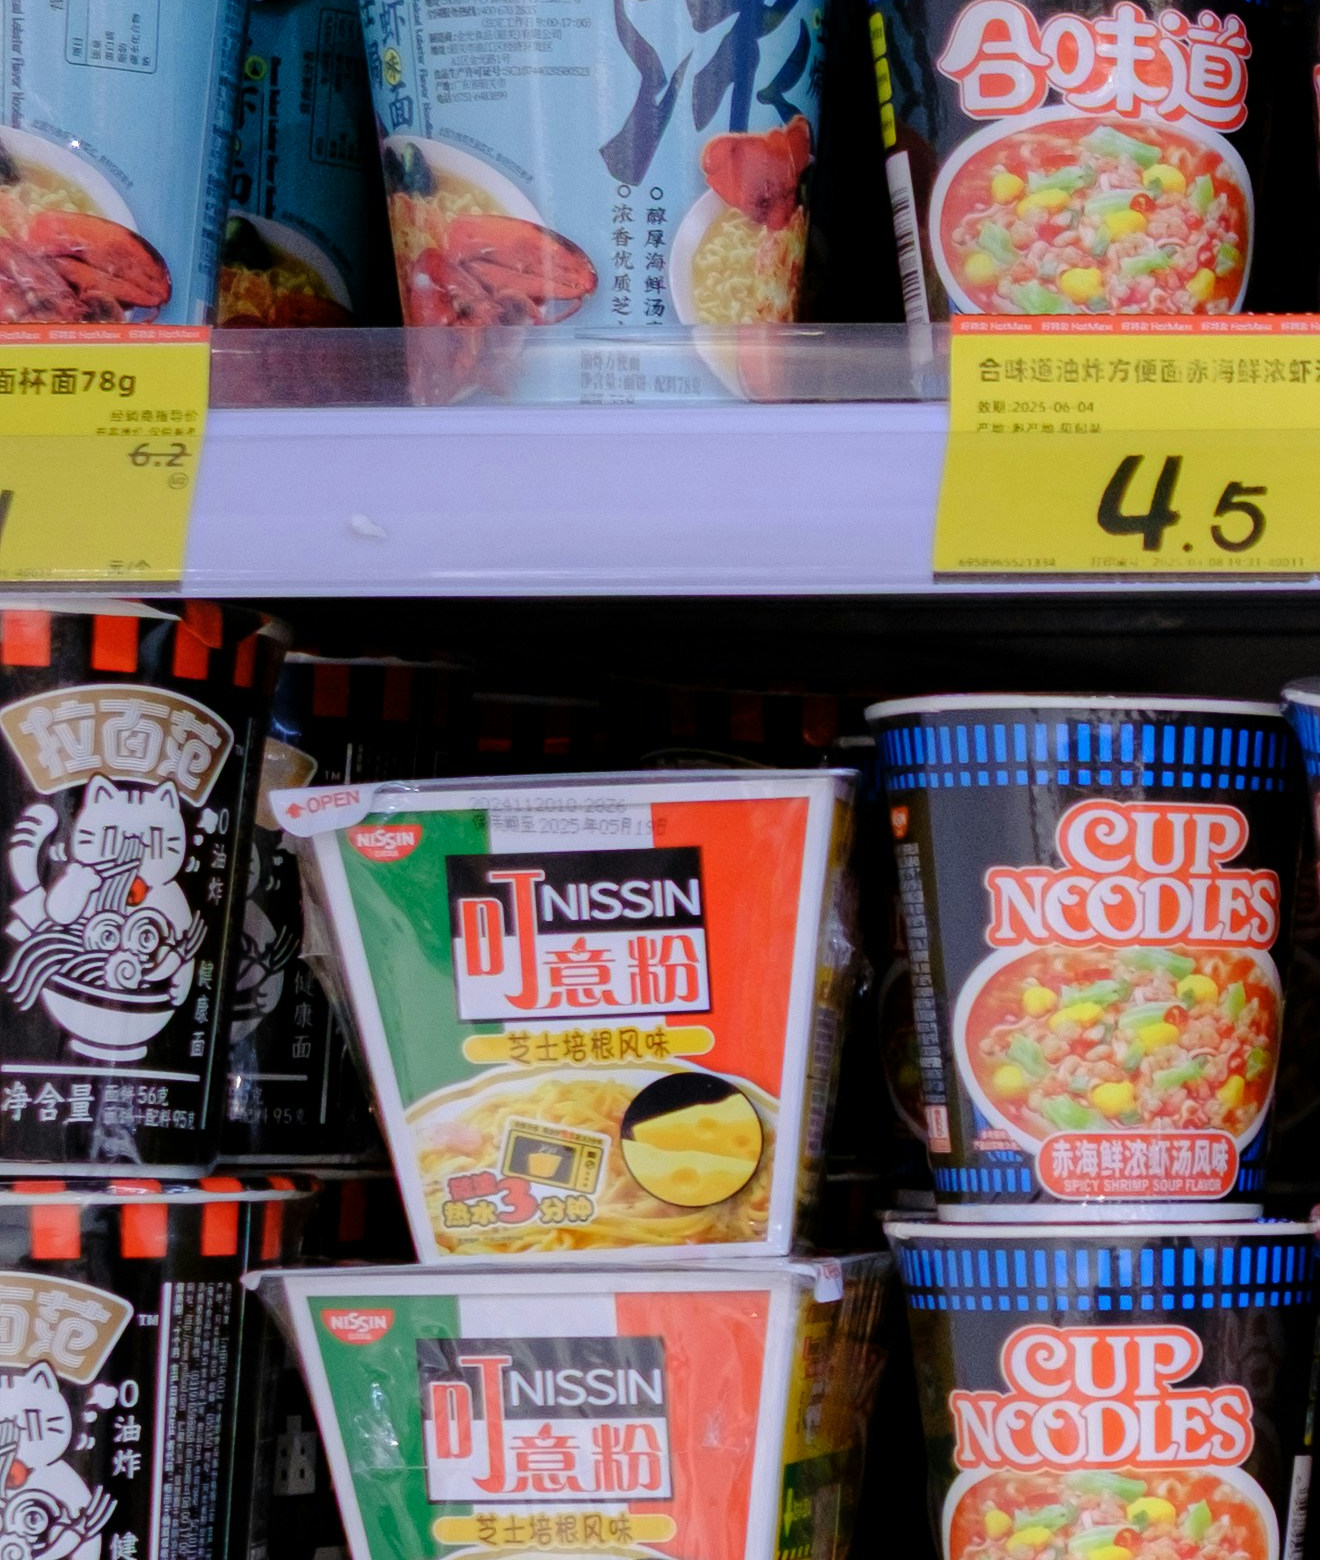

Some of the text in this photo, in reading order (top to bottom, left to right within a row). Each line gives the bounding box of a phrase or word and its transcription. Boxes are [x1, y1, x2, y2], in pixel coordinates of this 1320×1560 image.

[977, 400, 1095, 415] 效期:2025-06-04
[128, 443, 192, 467] 6.2
[1096, 454, 1268, 554] 4.5
[307, 788, 361, 815] OPEN
[1058, 801, 1250, 871] CUP
[542, 875, 703, 920] NISSIN
[988, 867, 1279, 947] NOODLES
[509, 1032, 672, 1063] 芝士培根风味
[1052, 1137, 1235, 1178] 赤海鲜浓虾汤风味
[509, 1370, 664, 1405] NISSIN
